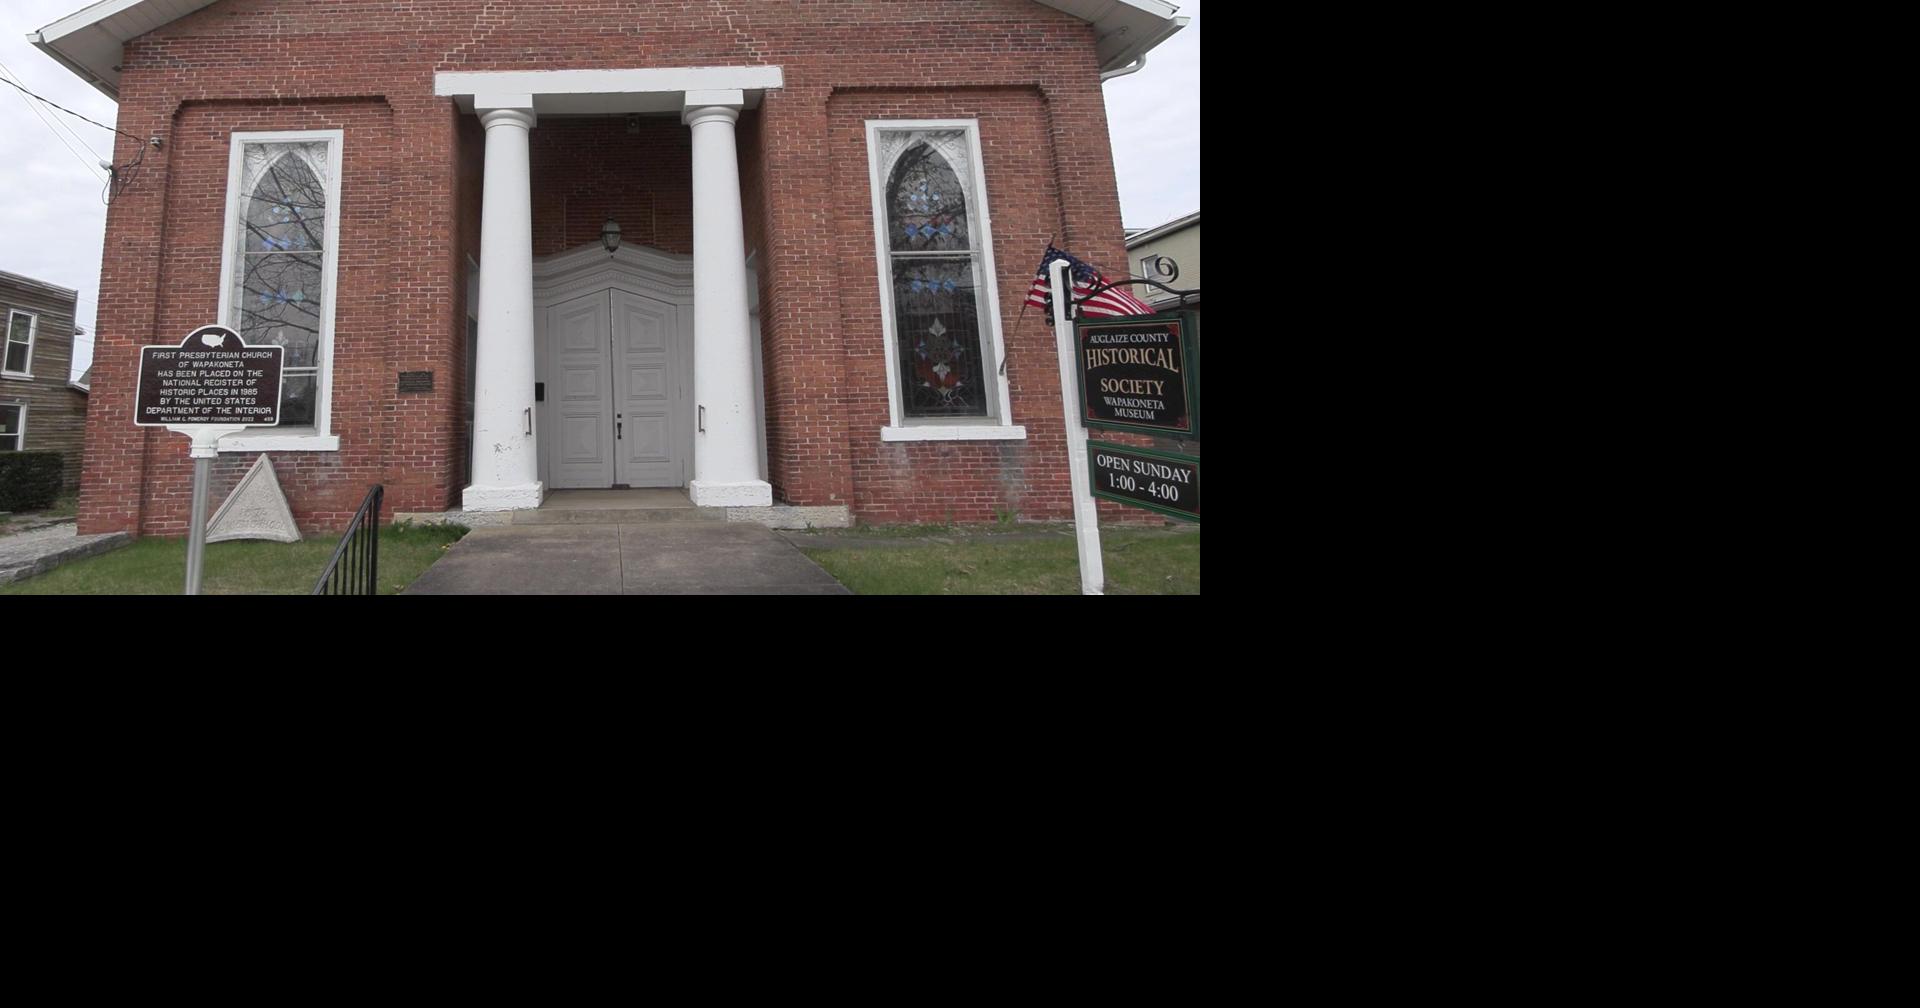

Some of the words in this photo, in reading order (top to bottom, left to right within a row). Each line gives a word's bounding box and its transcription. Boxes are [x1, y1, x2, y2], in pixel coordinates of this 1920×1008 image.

[1090, 335, 1129, 343] AUGLAIZE
[1130, 333, 1169, 342] COUNTY
[1086, 348, 1179, 373] HISTORICAL
[1100, 378, 1164, 396] SOCIETY
[1104, 397, 1165, 410] WAPAKONETA
[1115, 408, 1155, 420] MUSEUM
[1097, 454, 1130, 472] OPEN
[1133, 460, 1191, 484] SUNDAY
[1110, 473, 1135, 492] 1:00
[1148, 481, 1179, 501] 4:00
